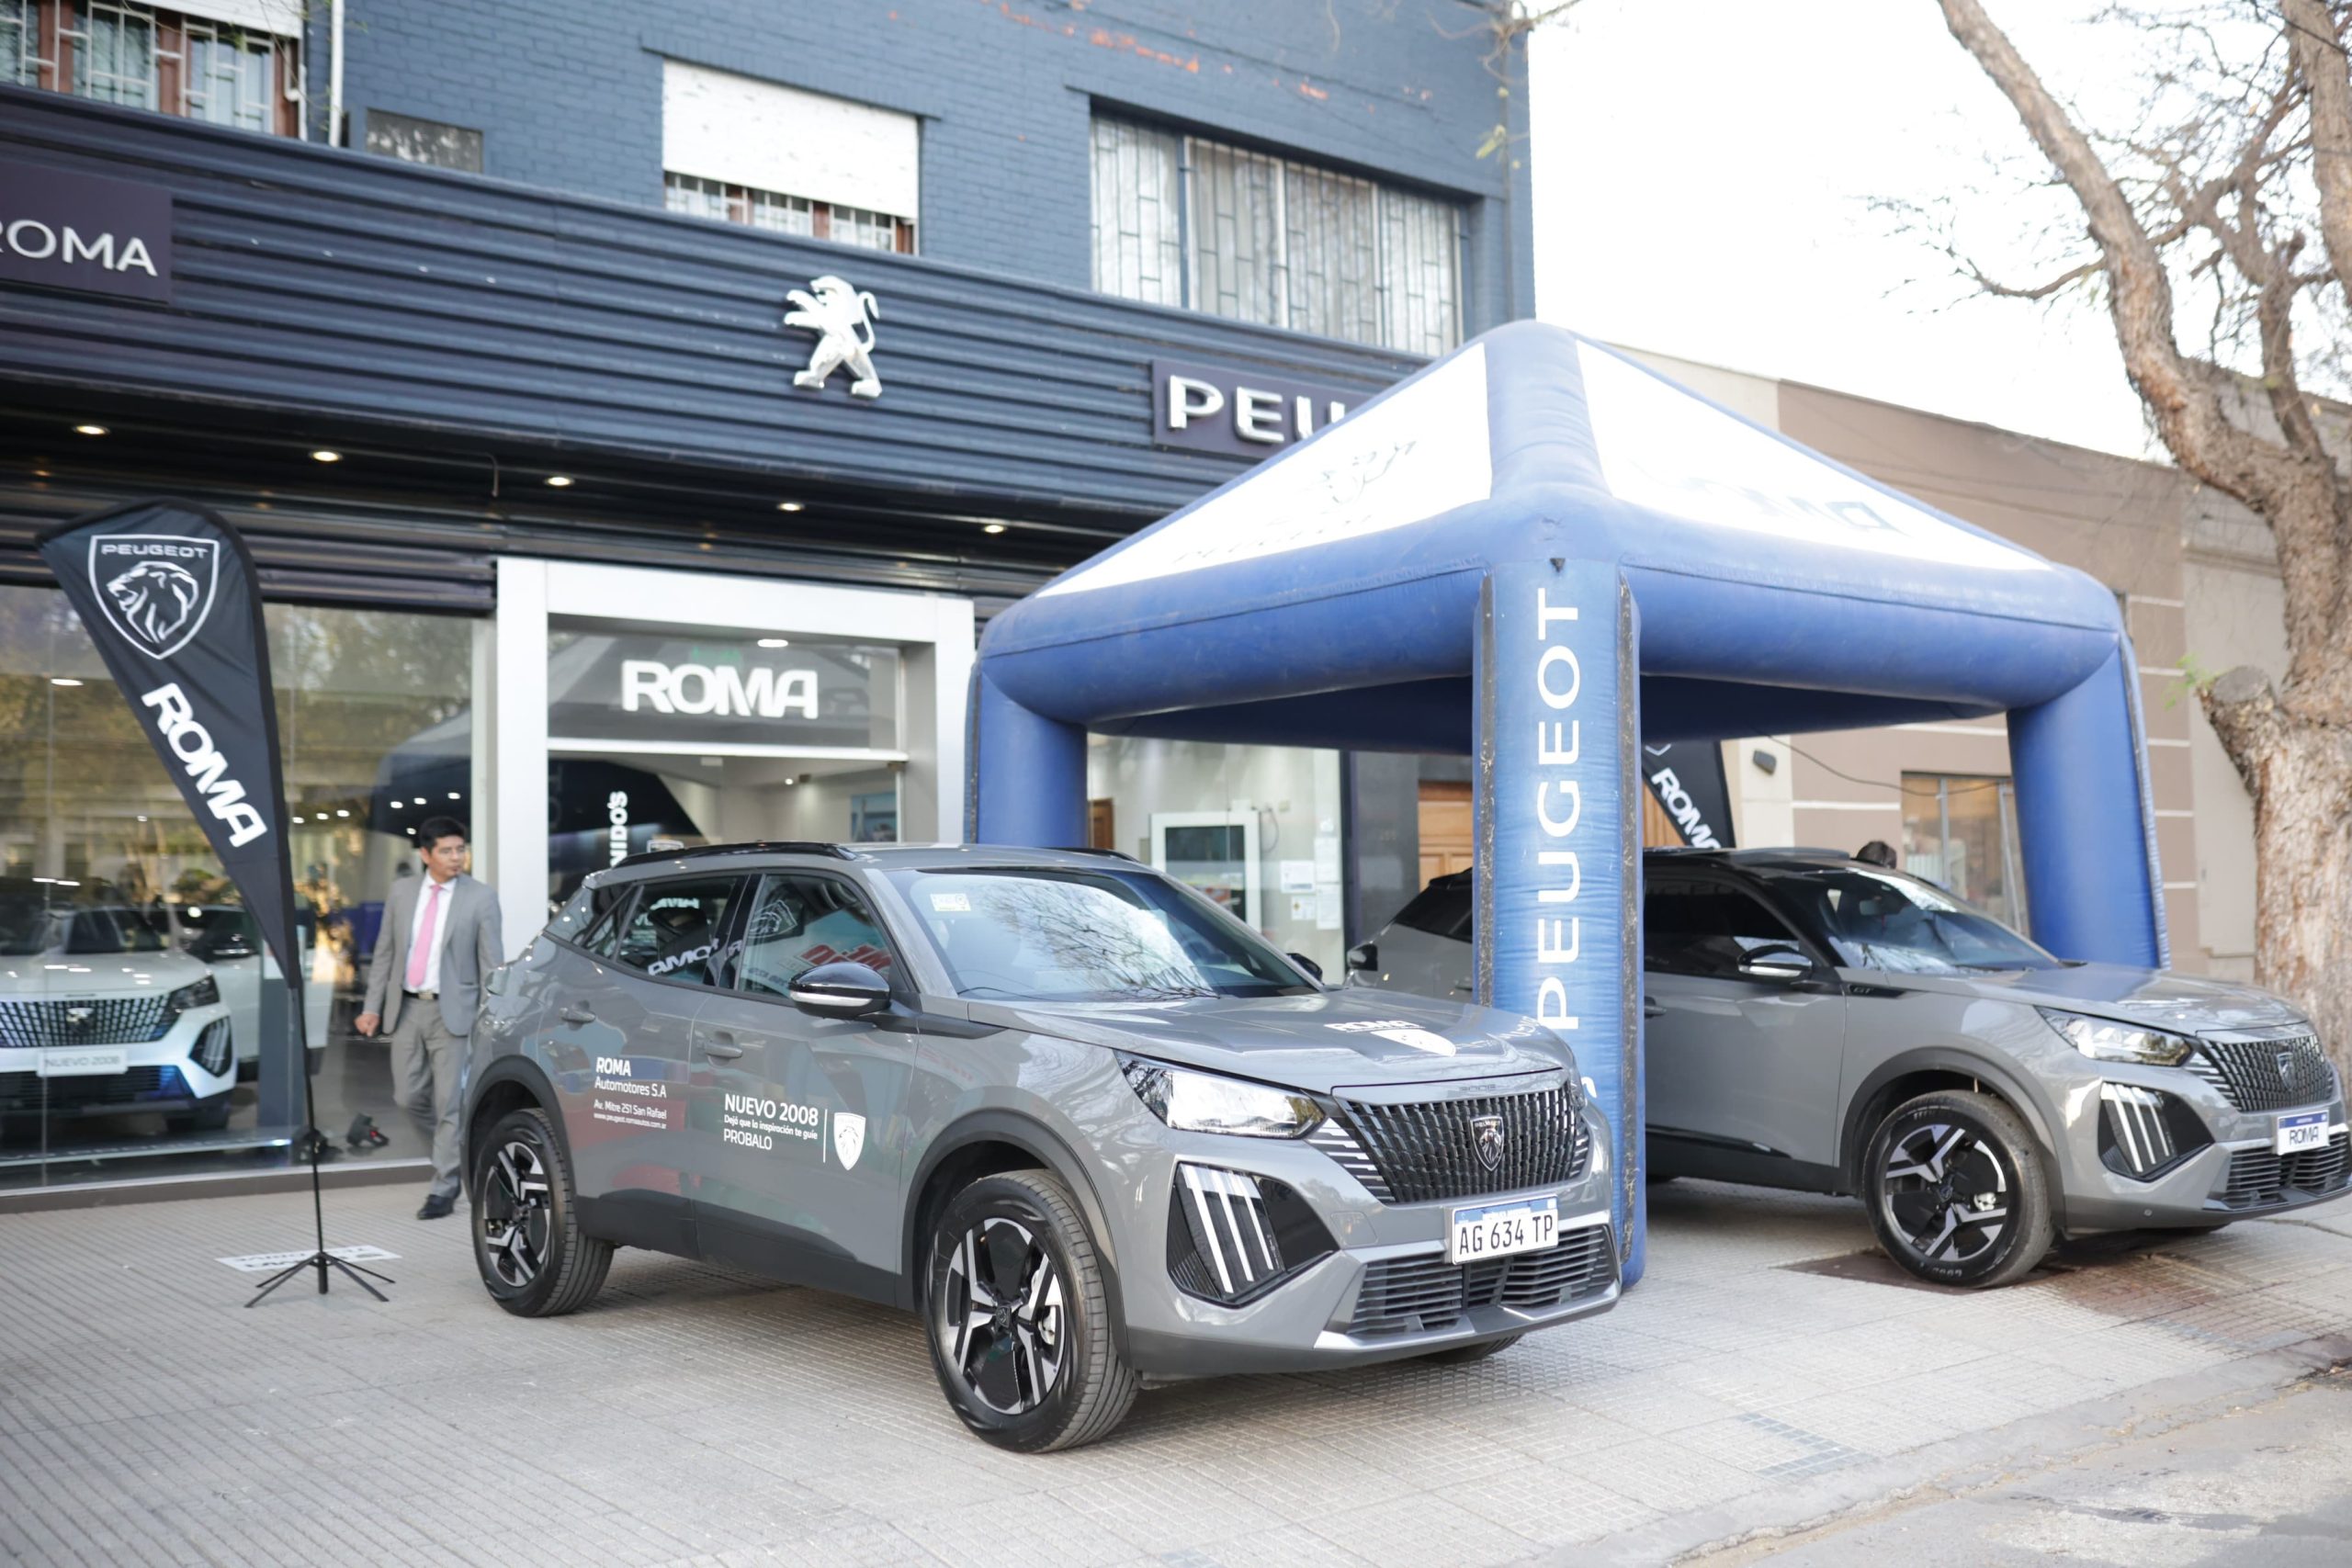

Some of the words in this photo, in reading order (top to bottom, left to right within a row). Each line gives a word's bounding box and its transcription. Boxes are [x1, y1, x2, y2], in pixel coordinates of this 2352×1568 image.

[0, 219, 159, 277] OMA
[101, 544, 209, 559] PEUGEOT
[621, 660, 820, 719] ROMA
[141, 682, 268, 849] ROMA
[1537, 587, 1581, 1031] PEUGEOT
[595, 1056, 632, 1077] ROMA
[594, 1076, 650, 1096] Automotores
[605, 1100, 621, 1112] Mitre
[633, 1104, 646, 1116] San
[646, 1107, 667, 1120] Rafael
[724, 1093, 776, 1119] NUEVO
[779, 1102, 819, 1126] 2008
[739, 1118, 751, 1129] que
[795, 1127, 802, 1137] te
[2290, 1126, 2319, 1145] ROMA
[723, 1128, 773, 1150] PROBALO
[1459, 1225, 1483, 1255] AG
[1490, 1219, 1524, 1249] 634
[1532, 1214, 1553, 1243] TP
